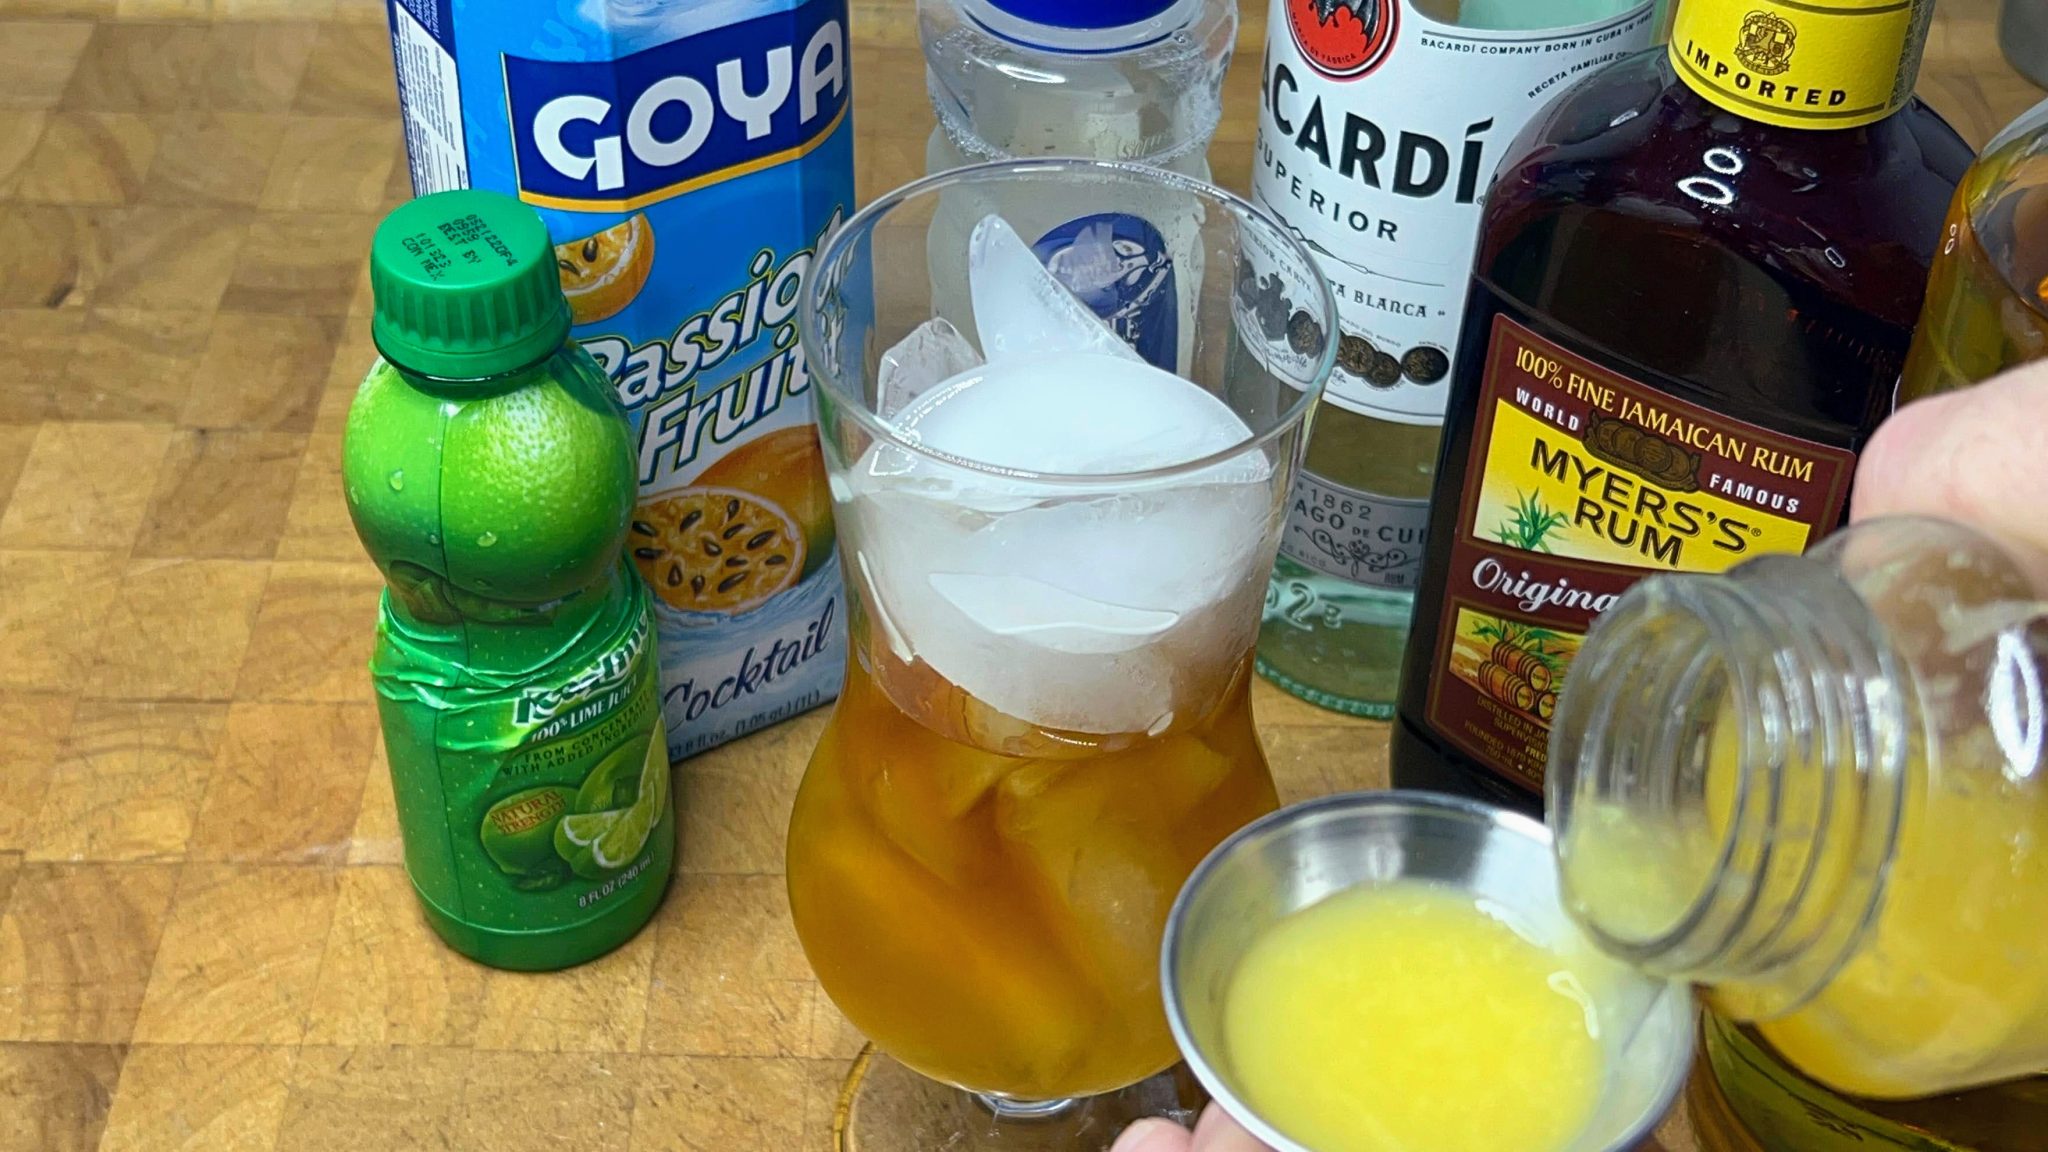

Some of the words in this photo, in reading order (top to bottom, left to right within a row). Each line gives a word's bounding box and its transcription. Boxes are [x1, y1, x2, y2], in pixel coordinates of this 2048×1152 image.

[1421, 37, 1475, 53] BACARDÍ
[1480, 46, 1540, 55] COMPANY
[1545, 41, 1577, 53] BORN
[1581, 37, 1592, 48] IN
[1596, 29, 1622, 43] CUBA
[1624, 22, 1634, 33] IN
[1528, 71, 1568, 99] RECETA
[1570, 52, 1614, 74] FAMILIAR
[1686, 40, 1847, 106] IMPORTED
[533, 20, 845, 191] GOYA
[1261, 44, 1495, 204] ACARDÍ
[1257, 128, 1399, 242] SUPERIOR
[437, 222, 469, 246] BEST
[1353, 289, 1428, 318] BLANCA
[1516, 346, 1563, 389] 100%
[1566, 372, 1617, 413] FINE
[1619, 396, 1747, 464] JAMAICAN
[1751, 446, 1815, 483] RUM
[1515, 387, 1580, 432] WORLD
[1709, 473, 1801, 514] FAMOUS
[1310, 487, 1373, 521] 1862
[1573, 495, 1684, 569] RUM
[1472, 557, 1621, 613] Origina
[664, 597, 836, 735] Cocktail
[531, 717, 568, 744] 100%
[570, 700, 606, 729] LIME
[502, 763, 540, 777] WITH
[550, 743, 594, 767] ADDED
[524, 746, 565, 764] FROM
[491, 790, 562, 825] NATURAL
[578, 896, 588, 908] 8
